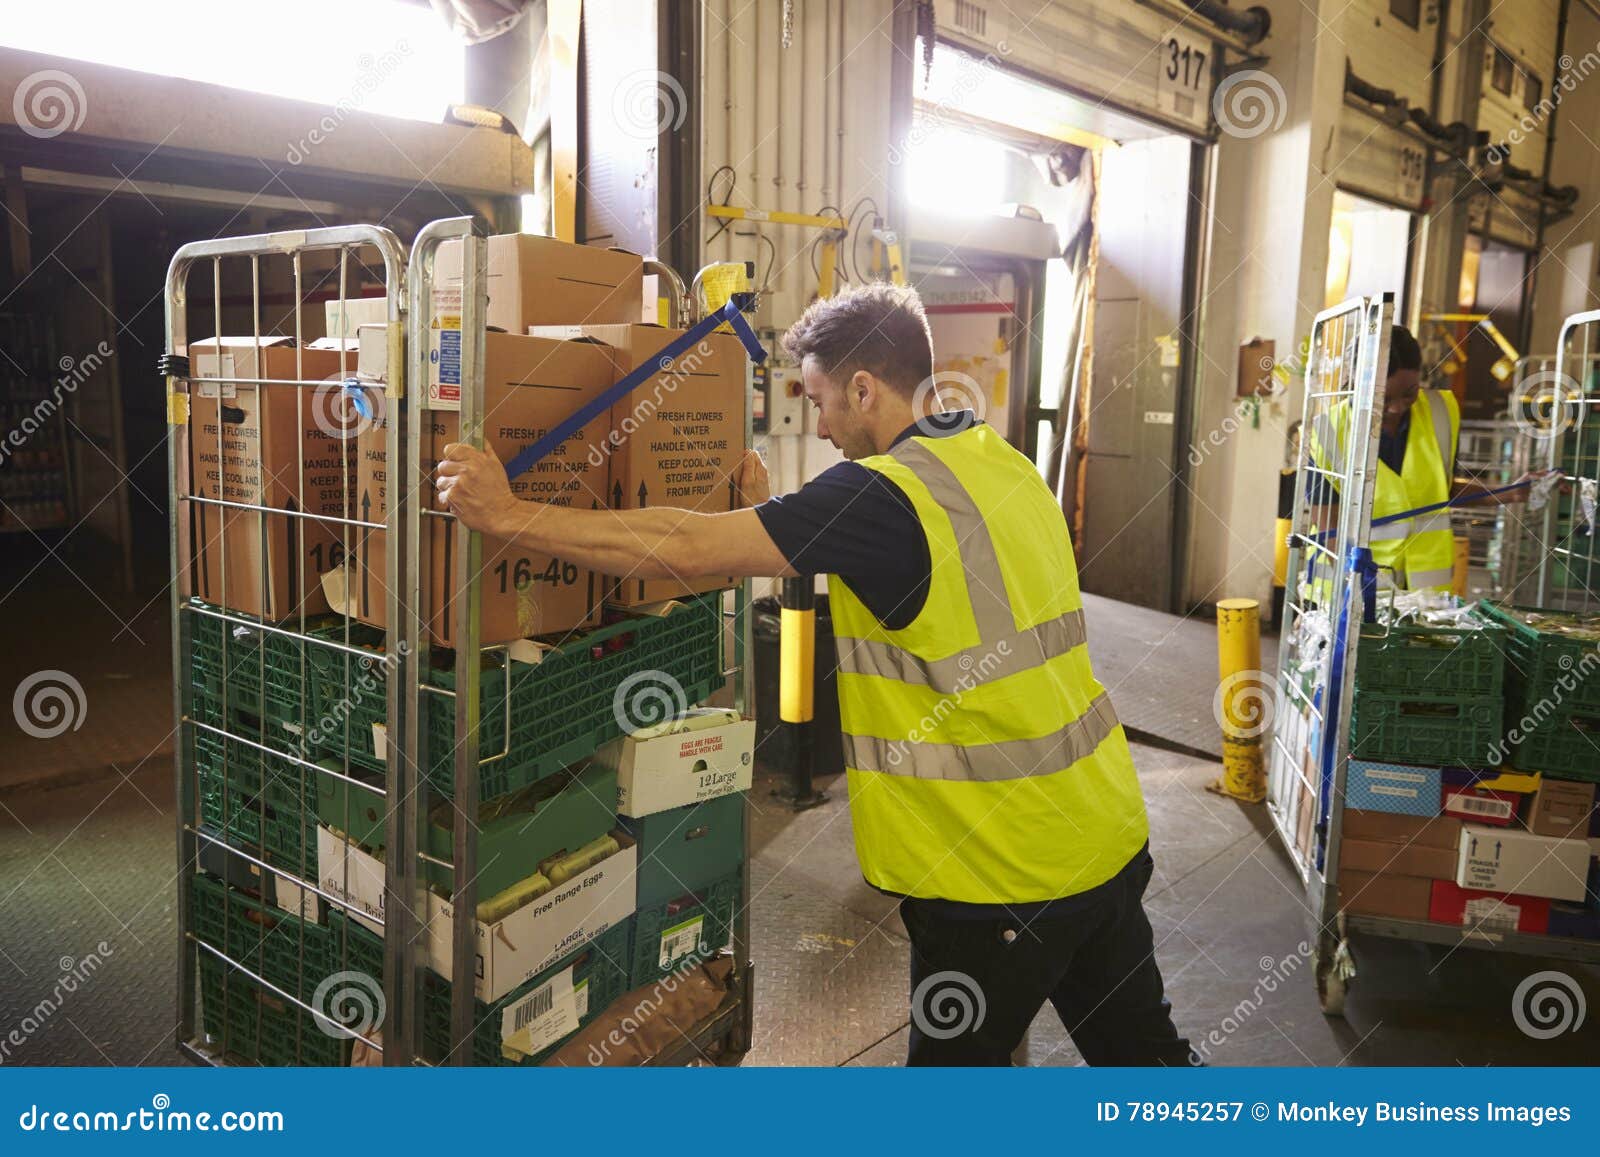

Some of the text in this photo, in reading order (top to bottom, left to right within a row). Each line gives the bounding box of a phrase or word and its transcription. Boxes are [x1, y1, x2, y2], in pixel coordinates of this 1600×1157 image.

[1167, 38, 1206, 91] 317
[656, 411, 723, 421] FRESH FLOWERS
[227, 425, 258, 439] FLOWERS
[499, 427, 535, 439] FRESH
[673, 426, 709, 435] IN WATER
[651, 440, 727, 452] HANDLE WITH CARE
[537, 462, 561, 472] WITH
[563, 462, 589, 473] CARE
[658, 457, 721, 470] KEEP COOL AND
[665, 471, 716, 483] STORE AWAY
[510, 480, 581, 492] EEP COOL AND
[666, 485, 714, 497] FROM FRUIT
[712, 743, 723, 752] CARE
[533, 871, 604, 918] Free Range Eggs
[554, 927, 585, 953] LARGE
